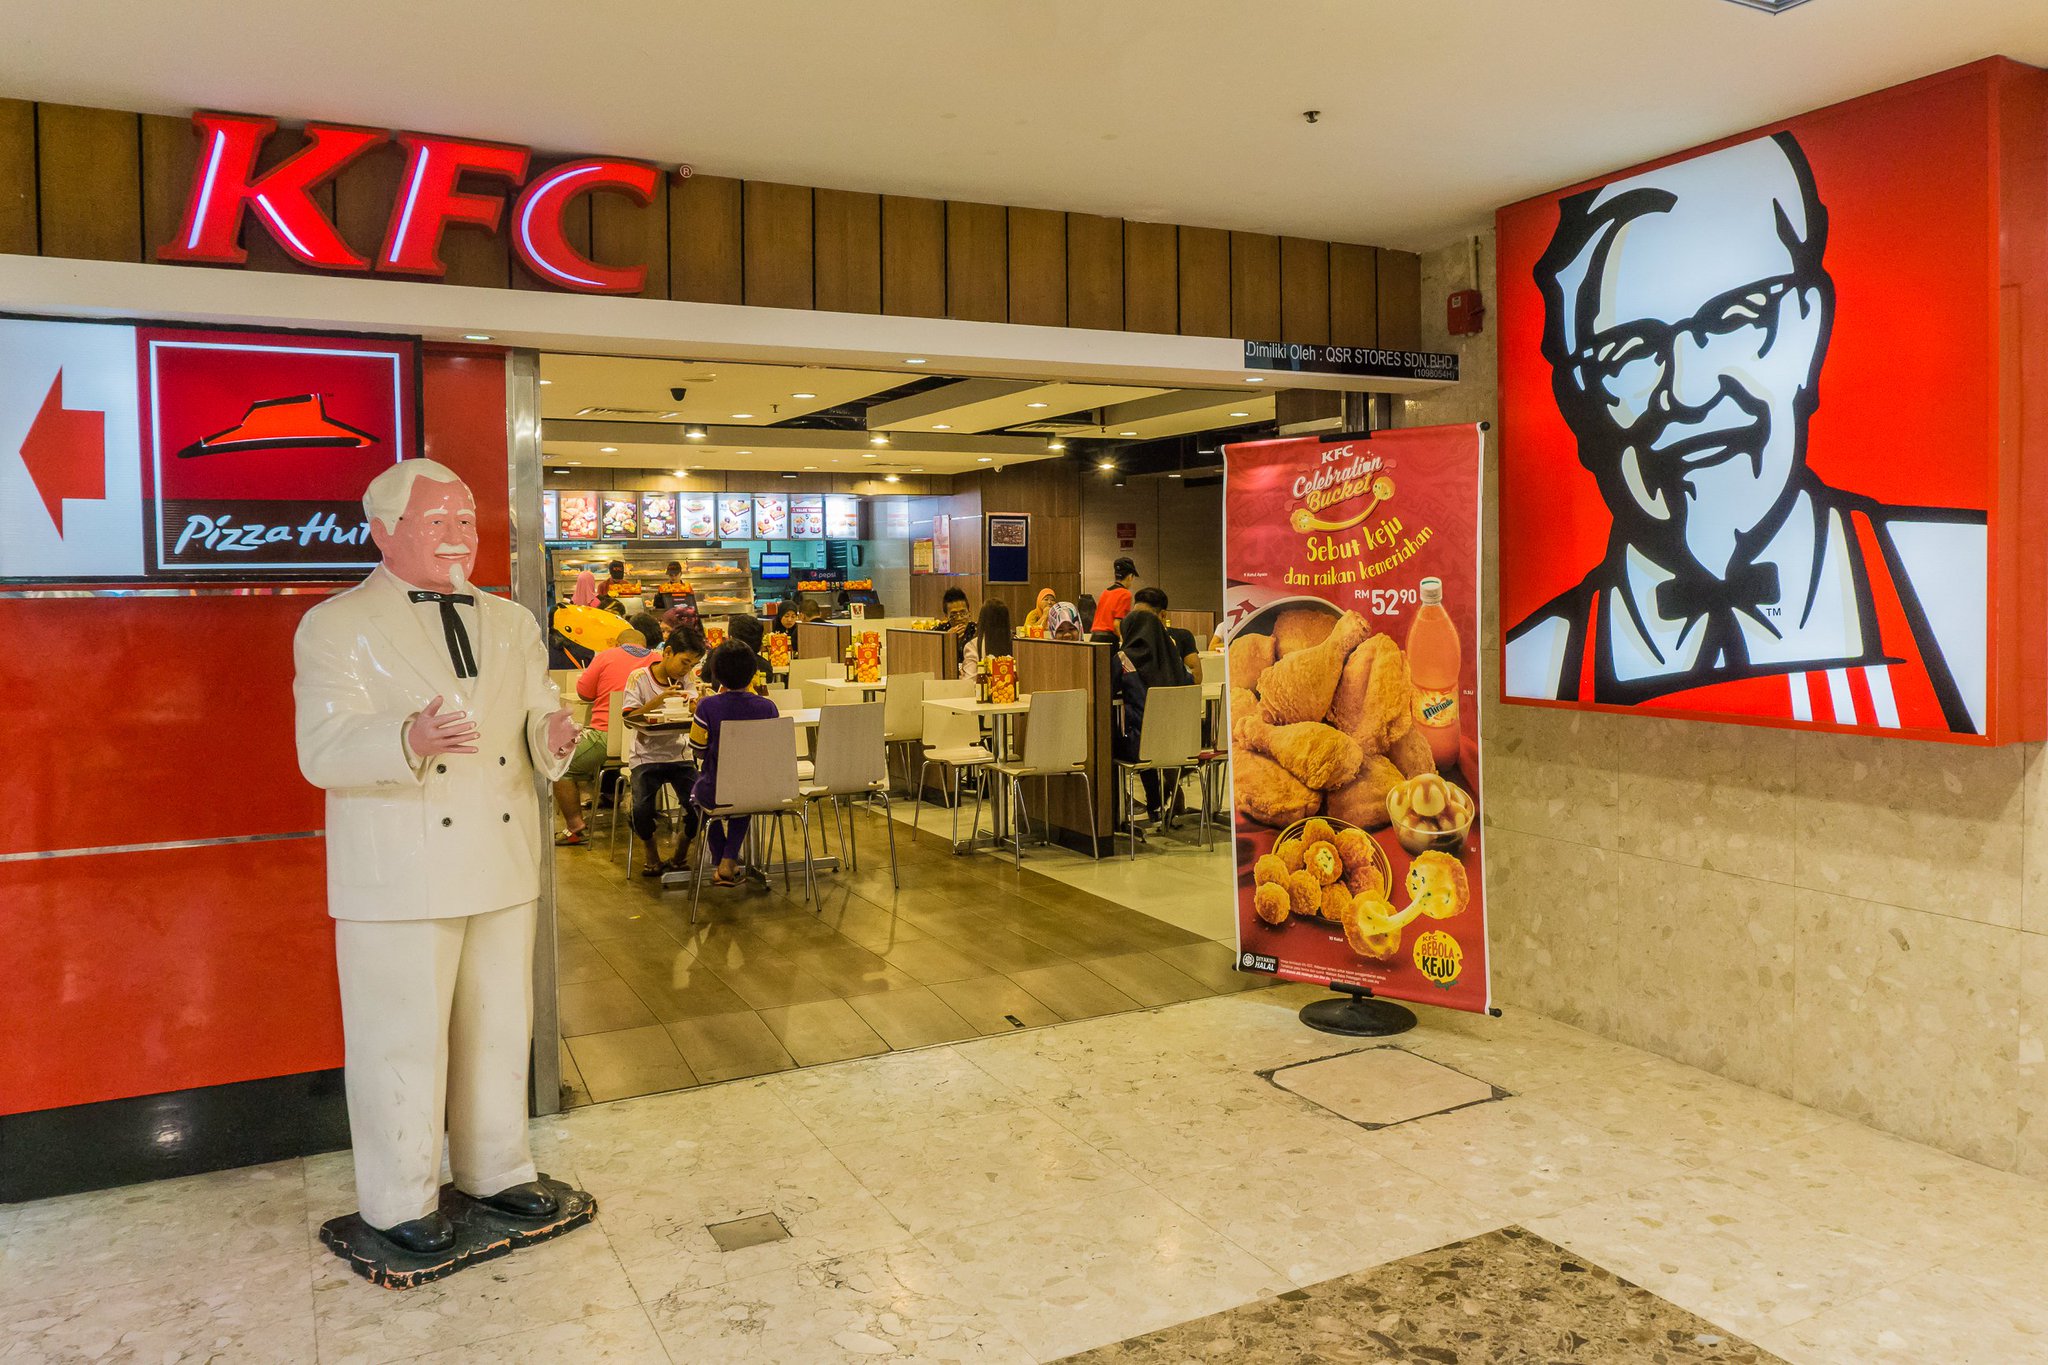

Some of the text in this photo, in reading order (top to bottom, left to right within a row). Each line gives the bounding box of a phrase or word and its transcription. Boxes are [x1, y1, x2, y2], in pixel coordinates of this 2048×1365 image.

[157, 110, 663, 296] KFC
[1246, 341, 1287, 359] Dimiliki
[1290, 344, 1316, 360] Oleh
[1325, 347, 1353, 363] QSR
[1354, 349, 1401, 366] STORES
[1321, 444, 1354, 464] KFC
[1292, 456, 1383, 499] Celebration
[1306, 473, 1373, 513] Bucket
[174, 514, 293, 555] Pizza
[1306, 516, 1403, 562] Sebut keju
[1283, 526, 1434, 586] dan raikan kemeriahan
[818, 571, 836, 579] pepsi
[1765, 607, 1782, 616] TM
[1423, 699, 1453, 719] Mirinda
[1422, 934, 1438, 942] KFC
[1421, 941, 1455, 959] BEBOLA
[1254, 961, 1275, 971] HALAL
[1422, 955, 1455, 978] KEJU
